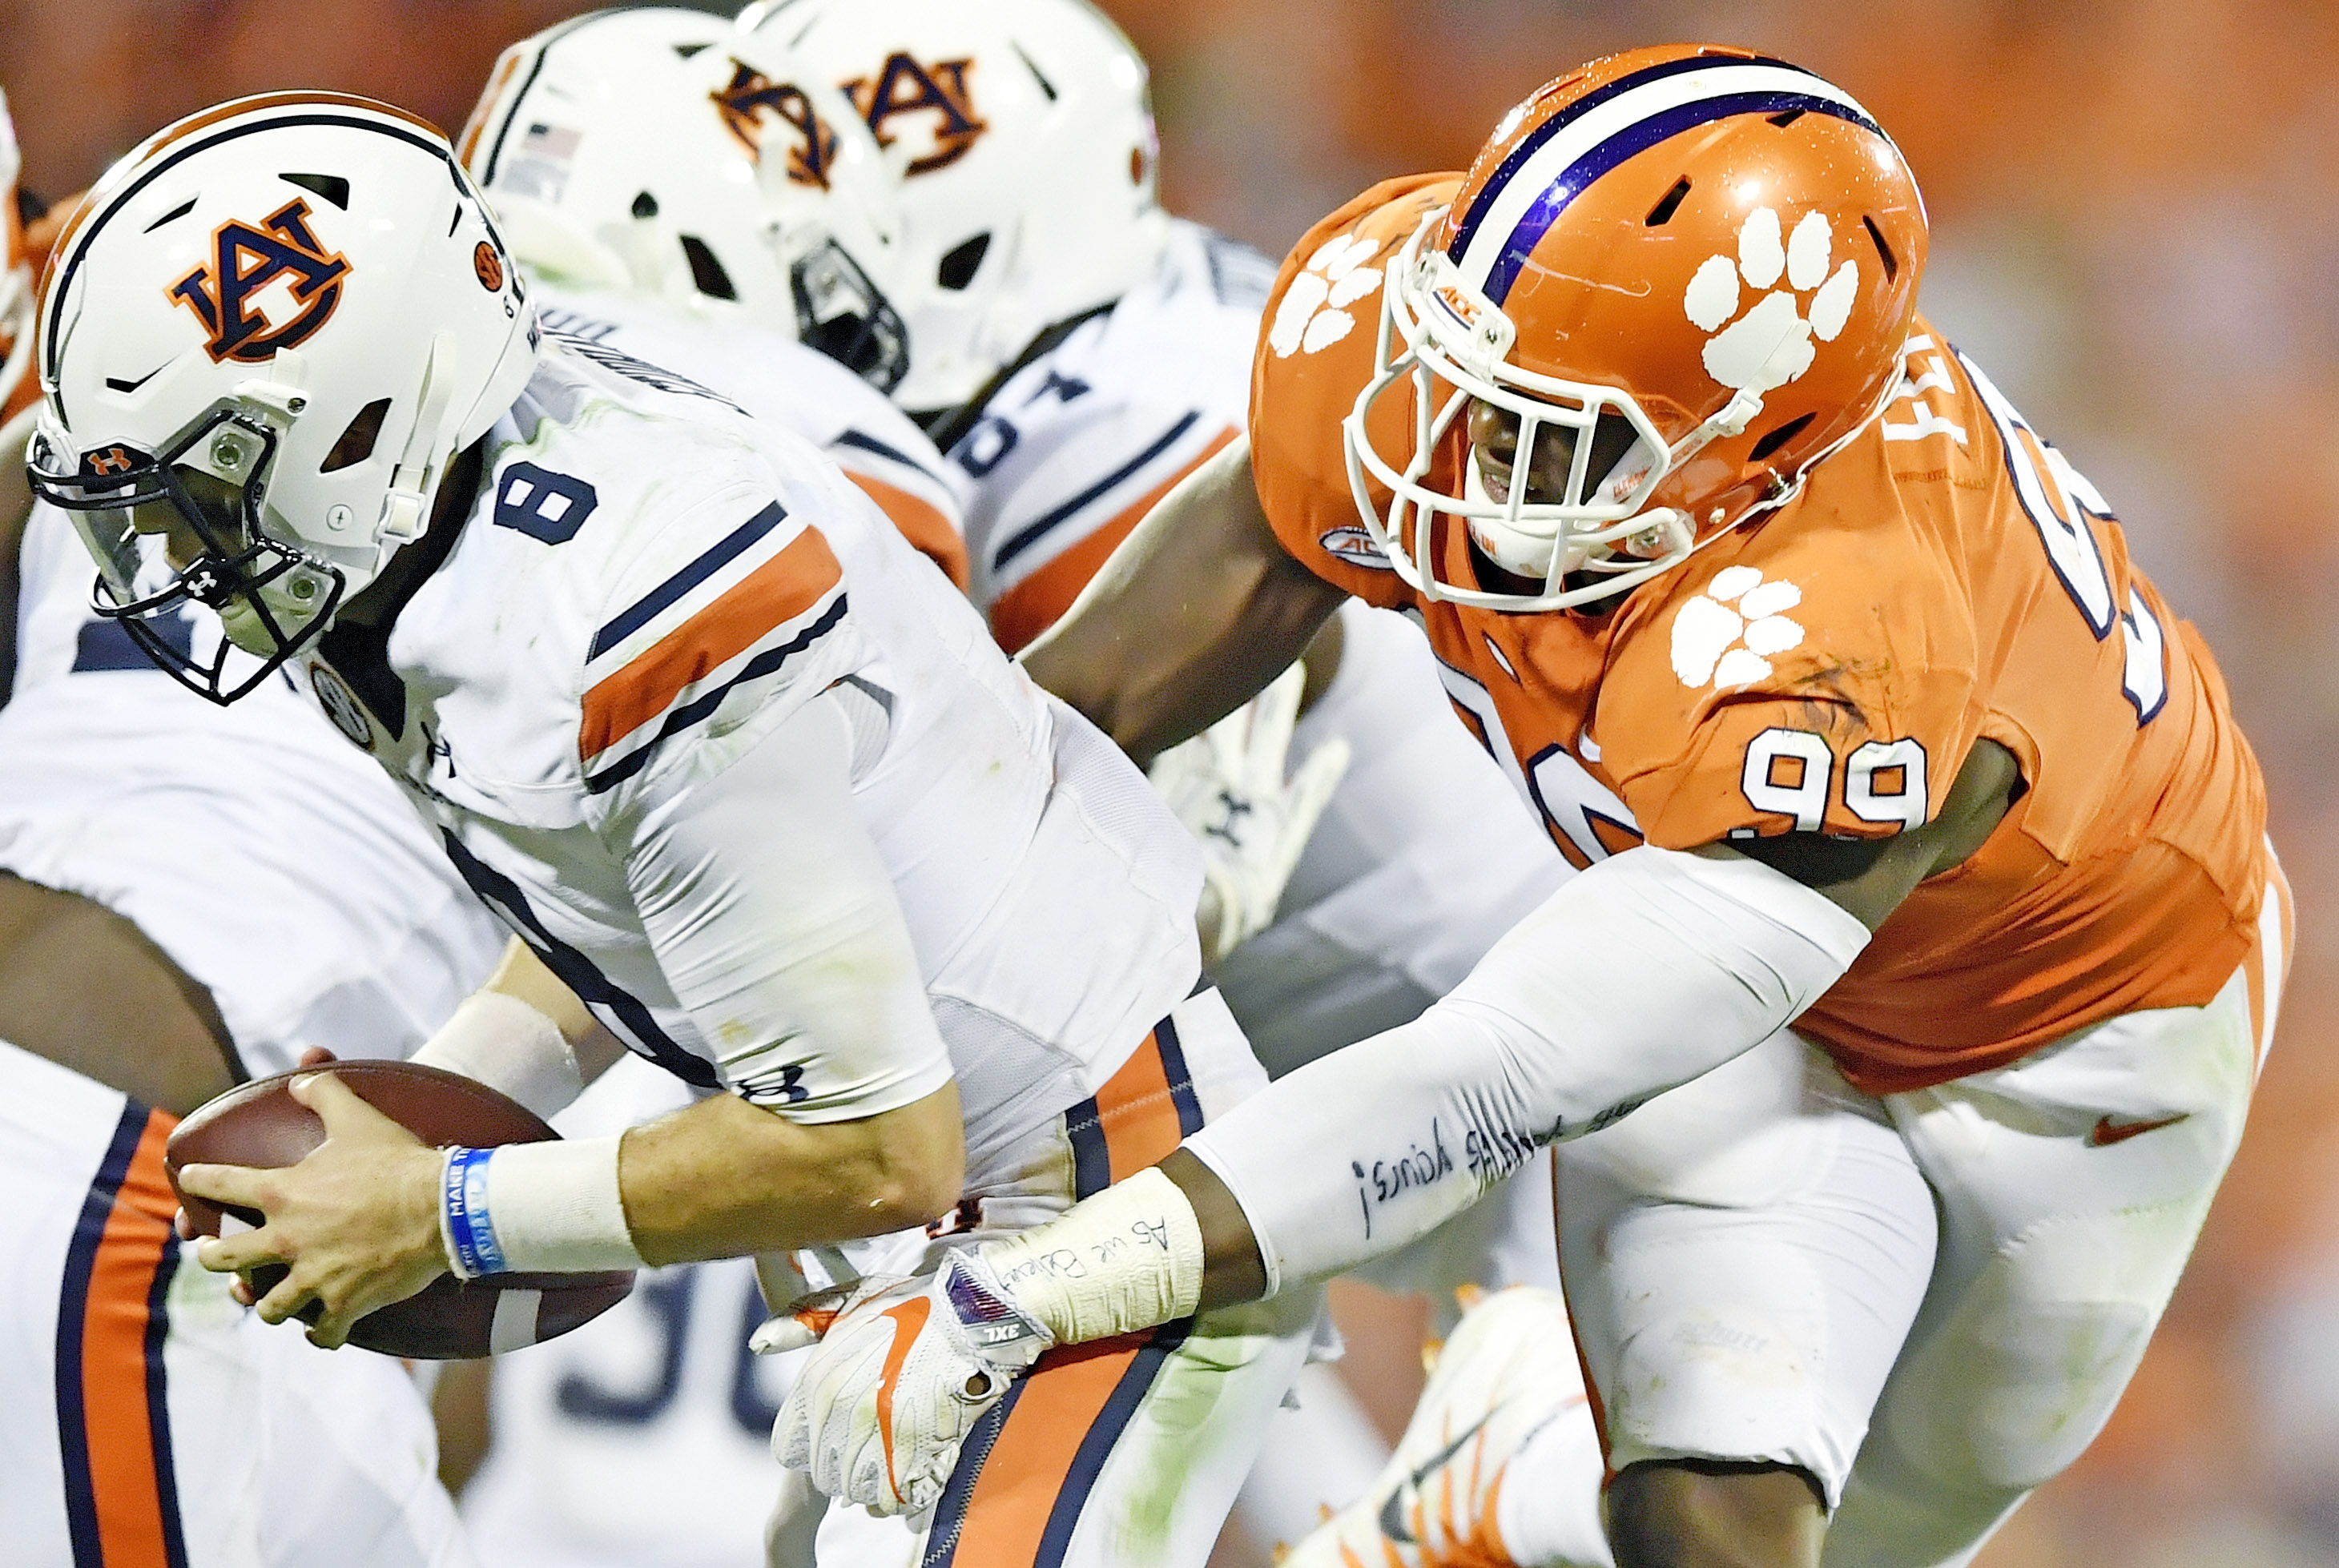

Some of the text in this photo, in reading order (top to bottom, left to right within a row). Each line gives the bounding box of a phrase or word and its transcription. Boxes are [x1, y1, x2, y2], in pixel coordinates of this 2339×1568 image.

[163, 197, 353, 364] AU
[1435, 286, 1481, 326] ACC
[493, 461, 598, 545] 8
[1741, 726, 1929, 834] 99
[448, 1164, 465, 1216] MAKE
[1352, 1116, 1453, 1240] yours!
[1132, 1216, 1168, 1251] As
[984, 1323, 1020, 1342] 3XL
